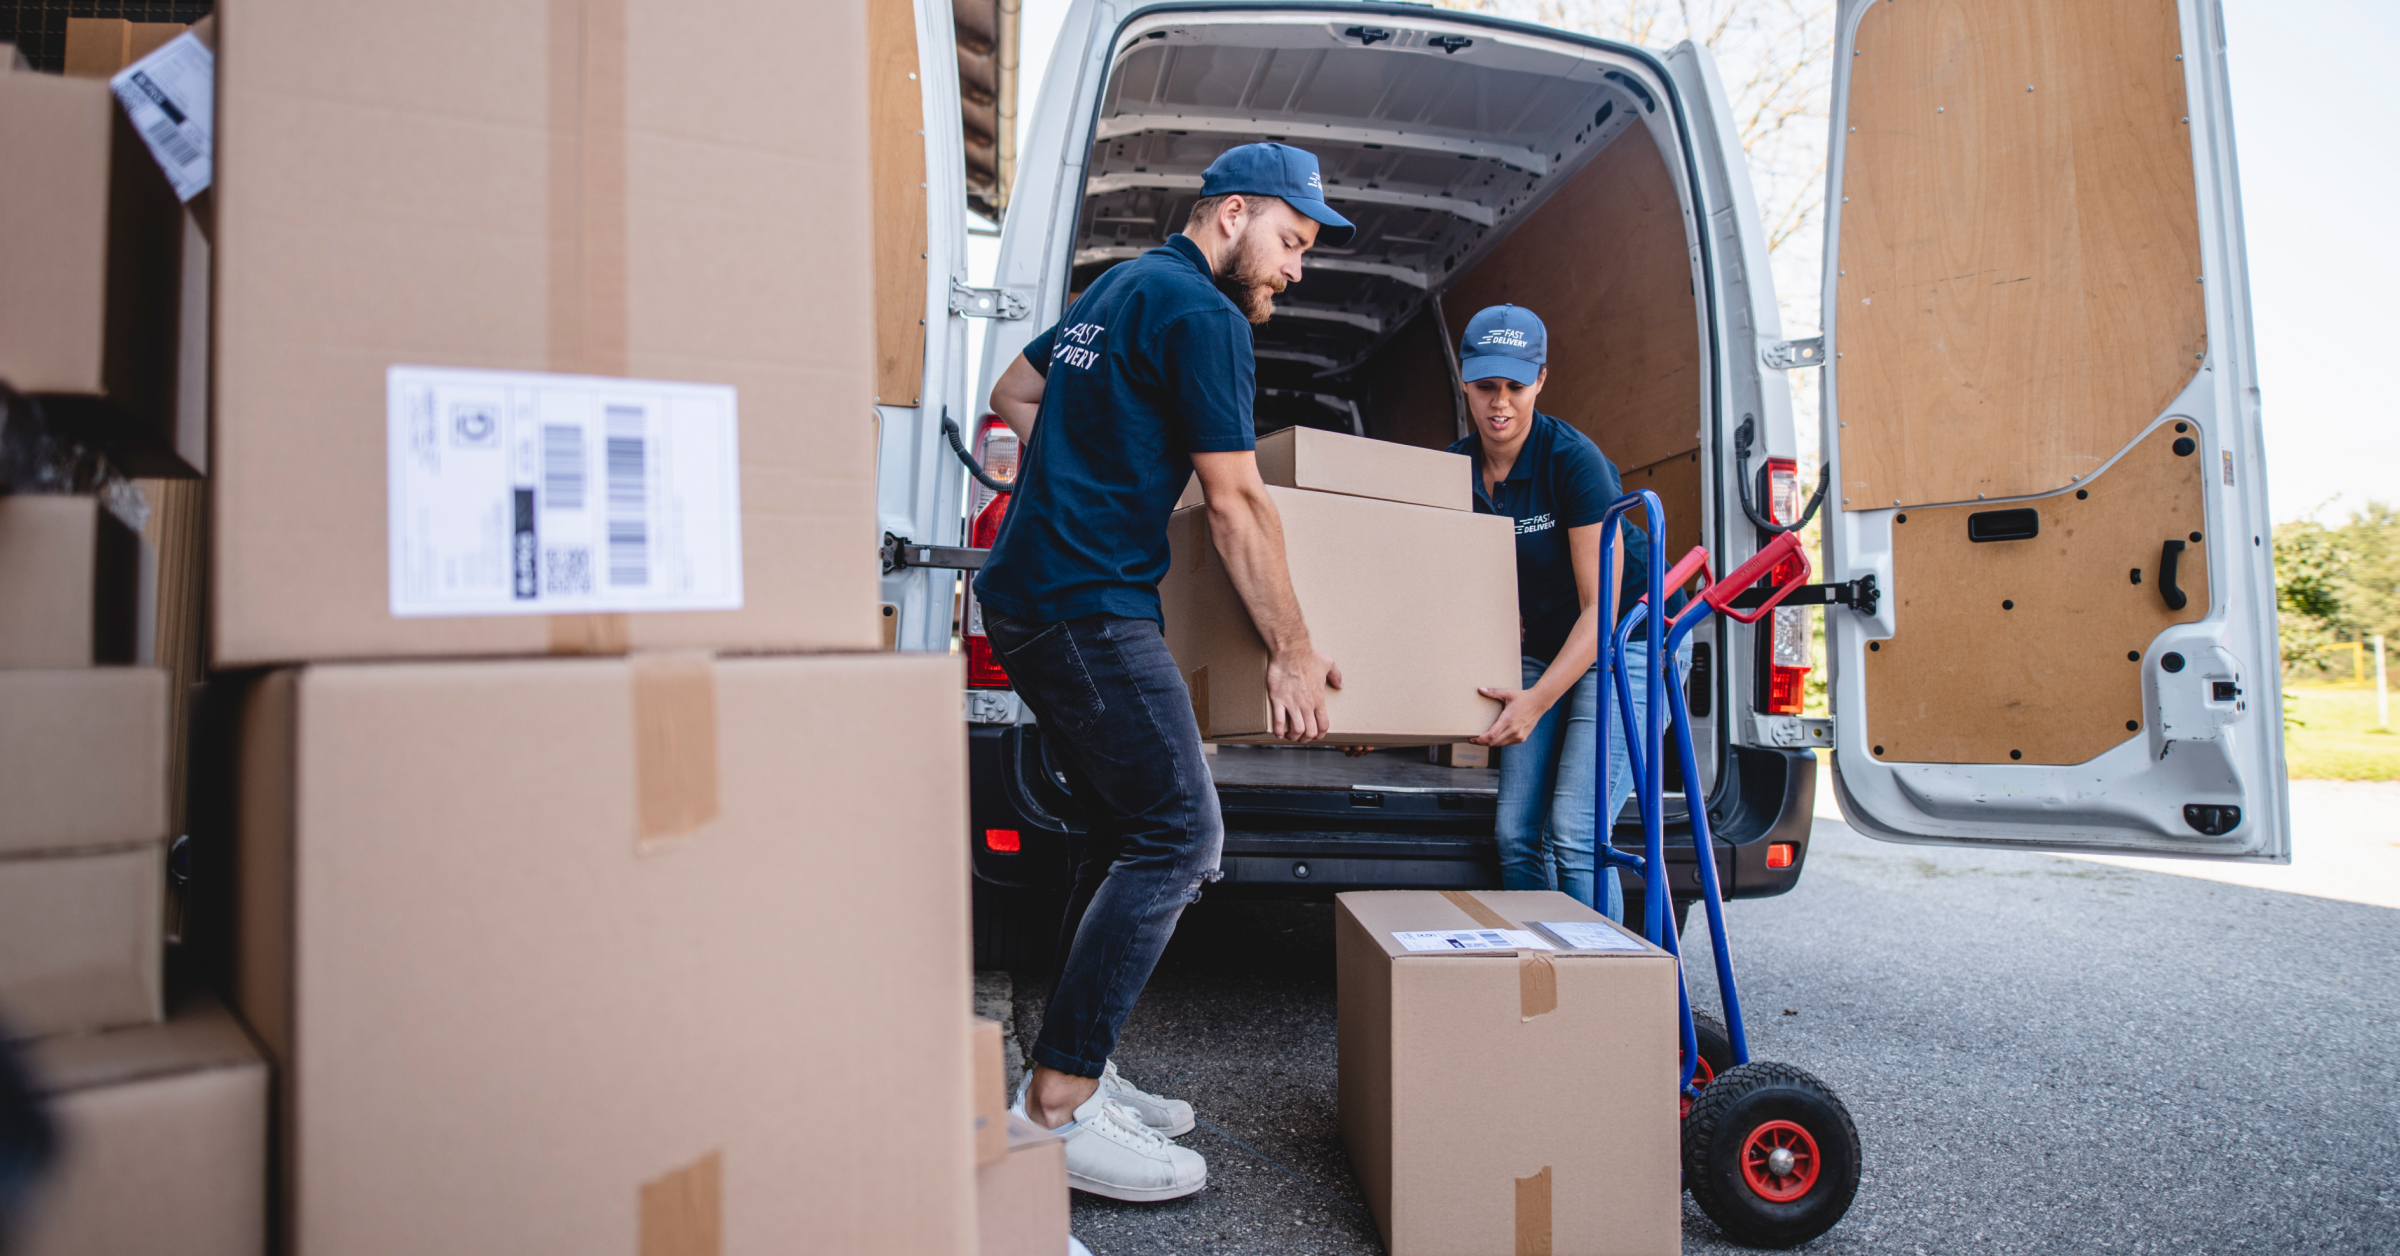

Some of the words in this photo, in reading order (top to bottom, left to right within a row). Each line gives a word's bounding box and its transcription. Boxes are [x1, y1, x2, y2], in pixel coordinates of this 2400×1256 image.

[1064, 322, 1105, 346] FAST
[1504, 328, 1524, 339] FAST
[1492, 337, 1527, 347] DELIVERY
[1055, 343, 1100, 370] IVERY
[1533, 512, 1551, 524] FAST
